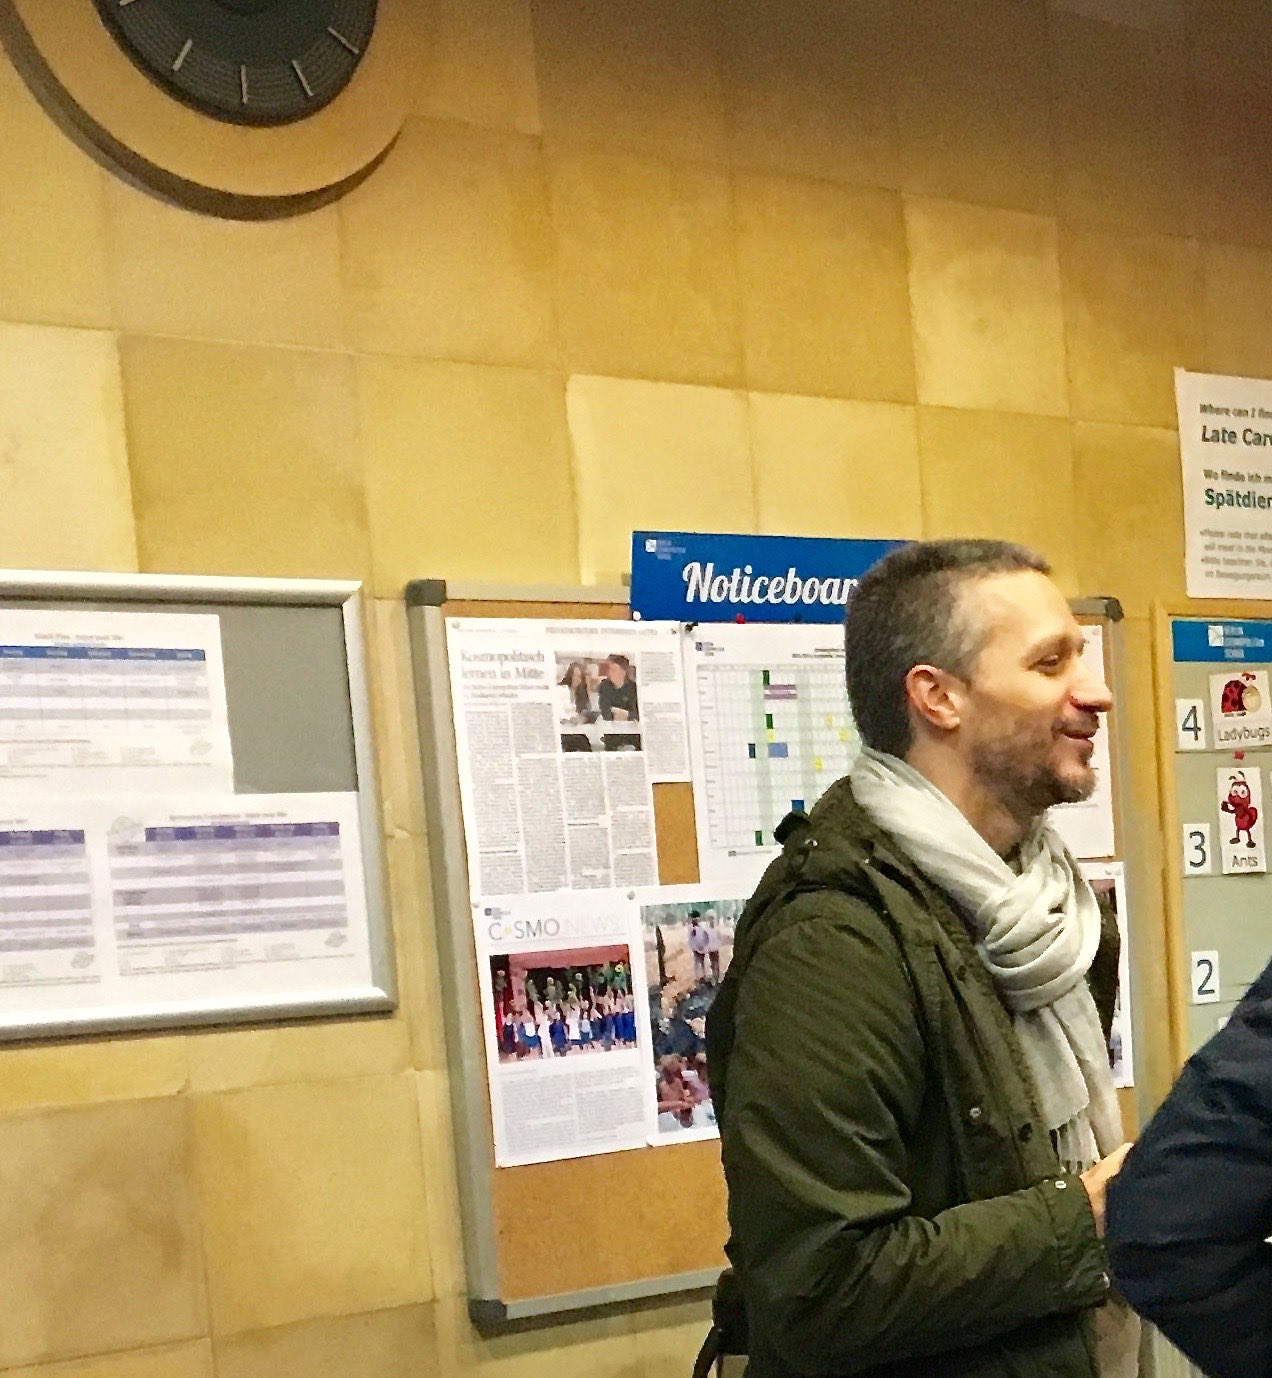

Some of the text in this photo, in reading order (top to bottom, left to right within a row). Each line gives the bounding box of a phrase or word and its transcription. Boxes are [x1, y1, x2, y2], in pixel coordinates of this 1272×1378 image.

[1202, 425, 1237, 444] Late
[682, 561, 858, 605] Noticeboar
[1182, 705, 1201, 741] 4
[1218, 725, 1271, 742] Ladybugs
[1189, 830, 1207, 868] 3
[1231, 855, 1258, 868] Ants
[488, 917, 560, 941] CSMO
[1196, 958, 1215, 996] 2
